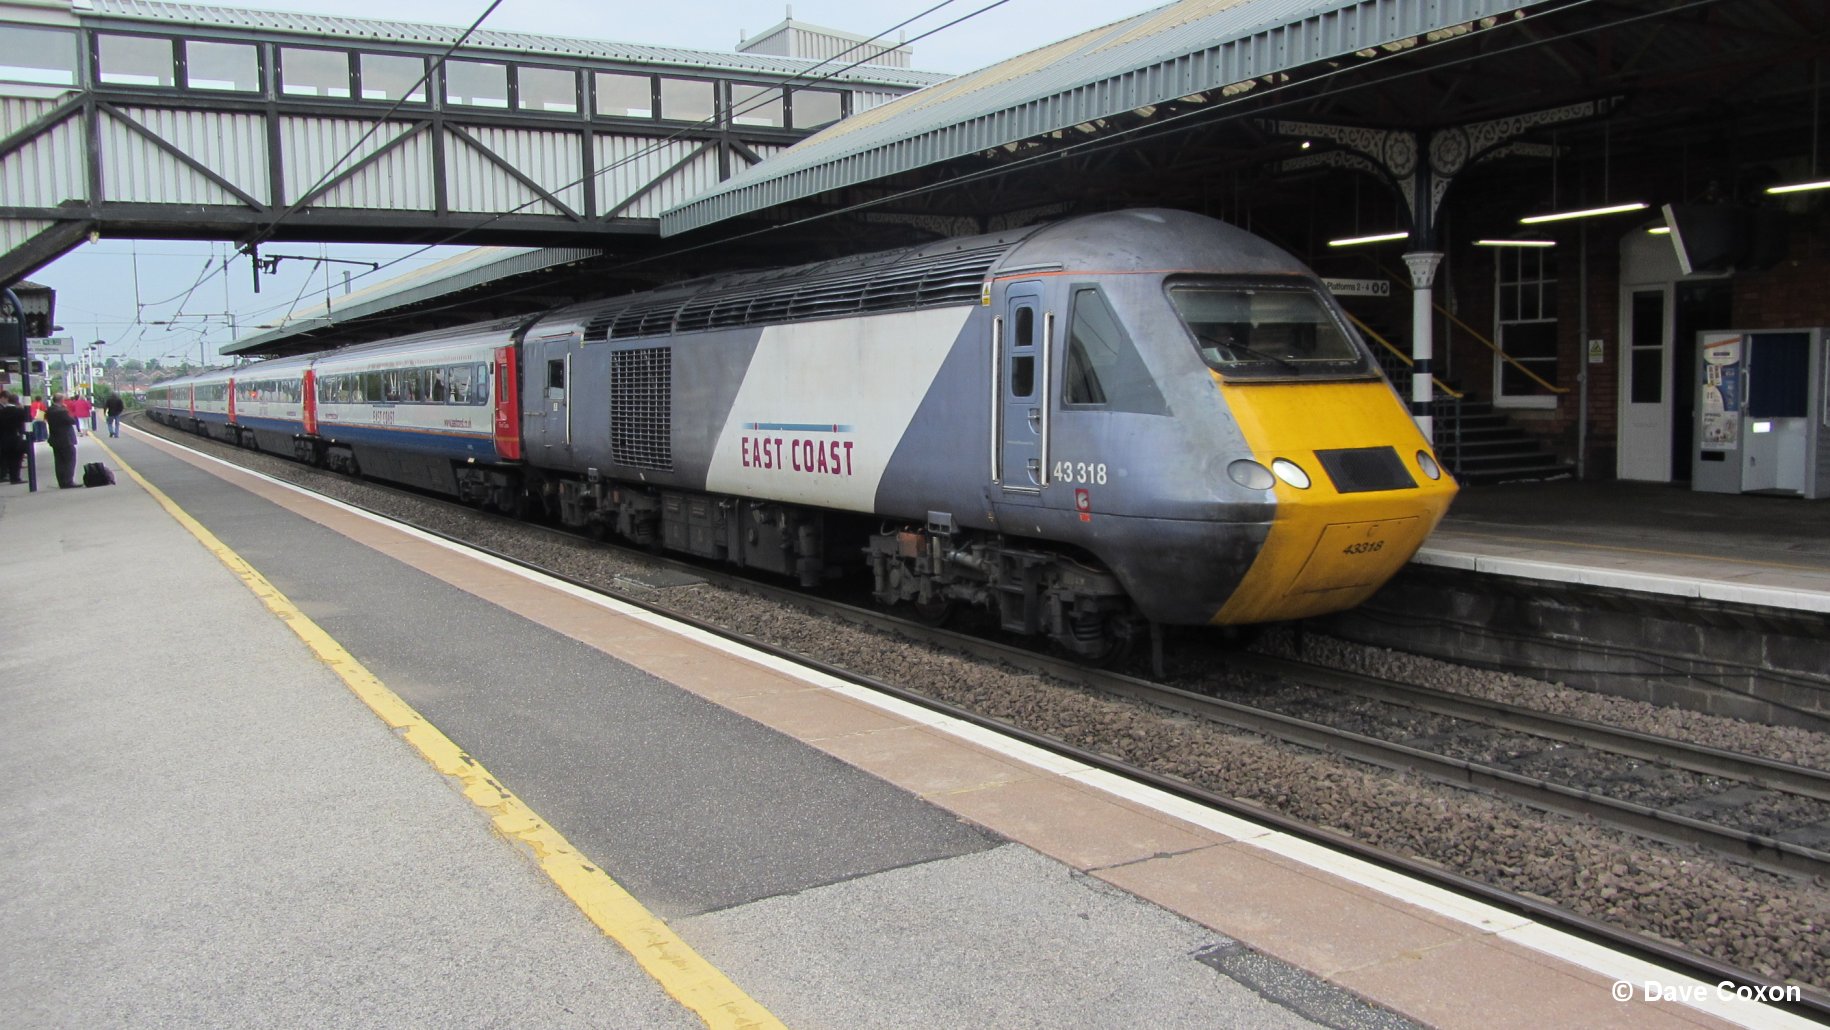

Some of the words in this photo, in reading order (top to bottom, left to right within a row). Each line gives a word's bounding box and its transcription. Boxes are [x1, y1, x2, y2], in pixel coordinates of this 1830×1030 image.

[1327, 281, 1355, 291] Platforms
[741, 436, 783, 470] EAST
[791, 439, 854, 476] COAST
[1053, 461, 1073, 482] 43
[1077, 462, 1107, 485] 318
[1343, 540, 1385, 555] 43318
